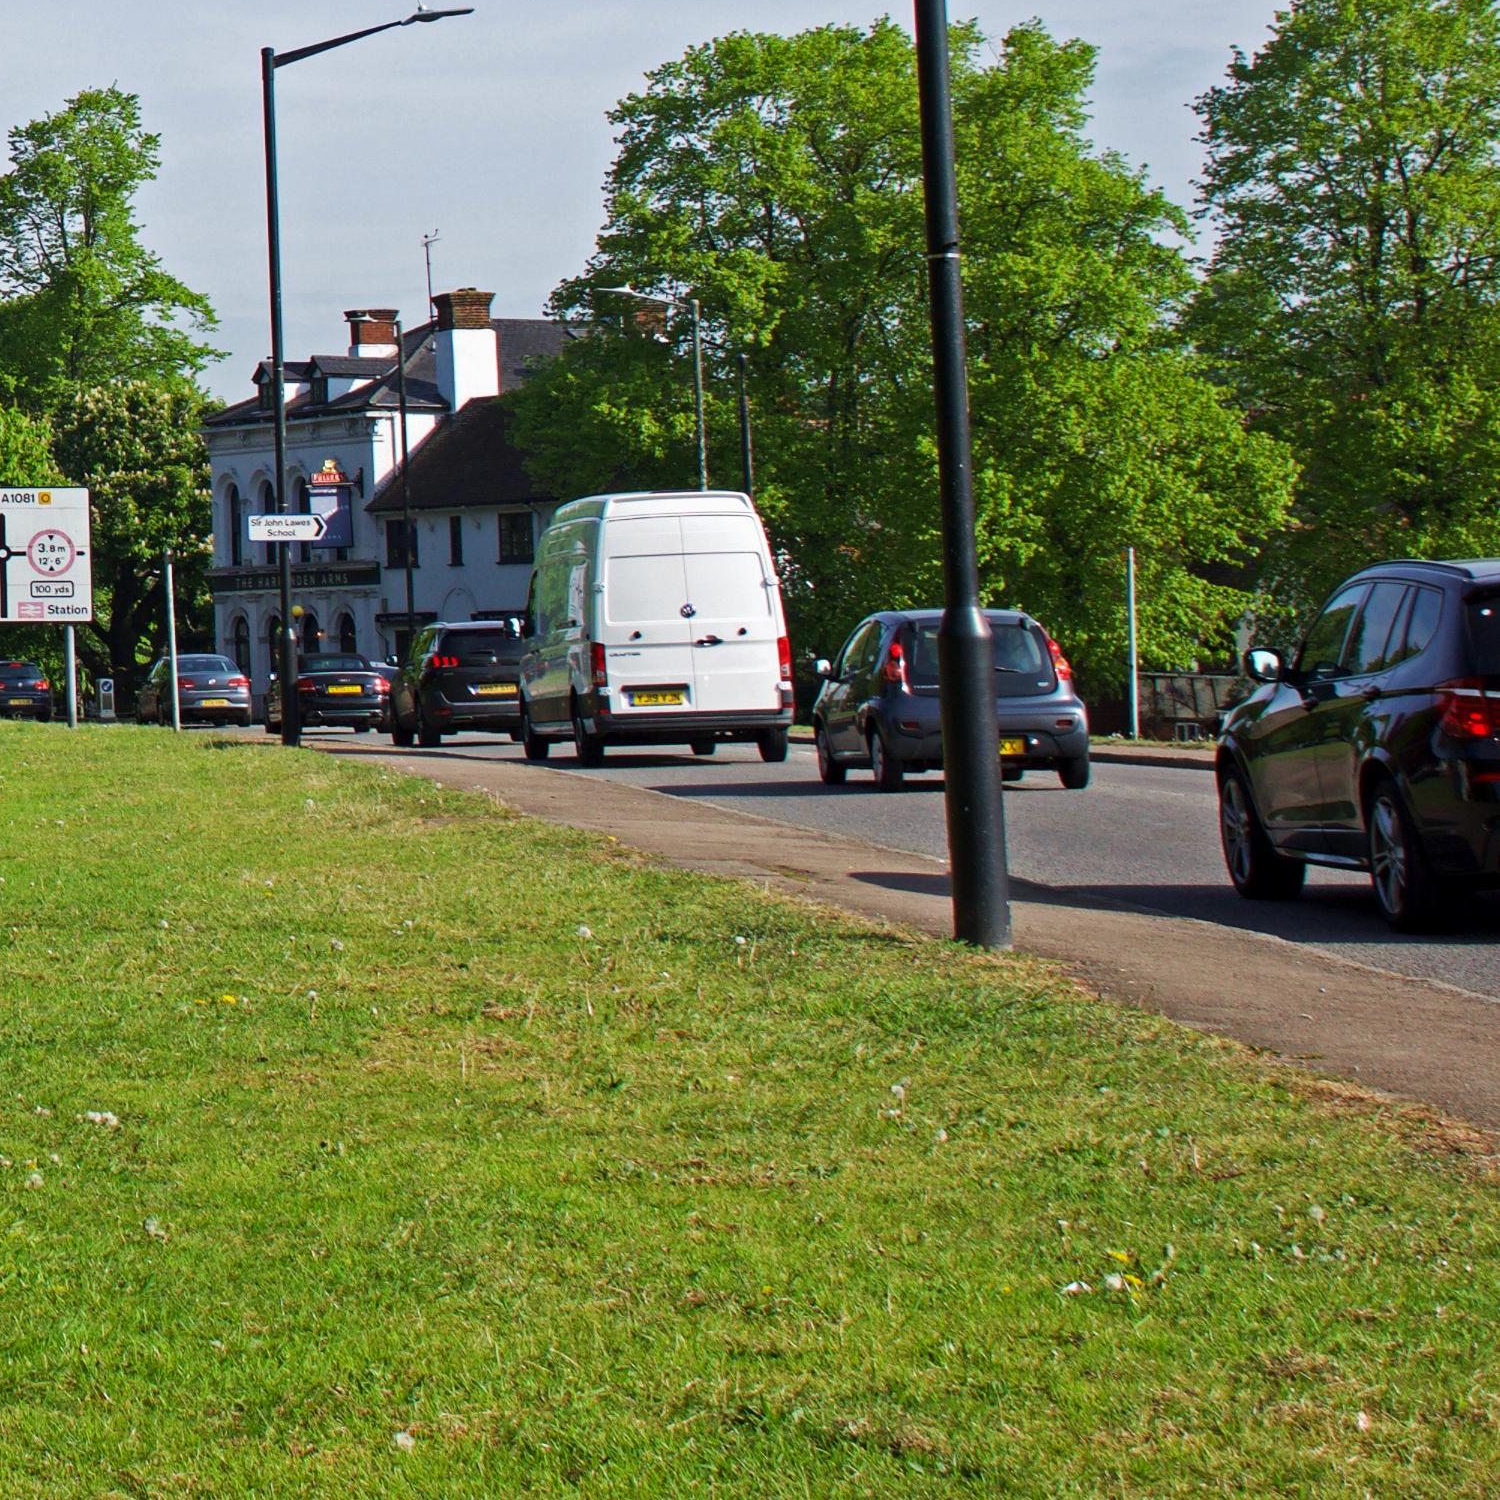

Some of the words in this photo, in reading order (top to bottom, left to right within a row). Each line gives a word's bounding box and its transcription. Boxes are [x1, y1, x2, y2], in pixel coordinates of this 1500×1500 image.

[1, 493, 35, 504] A1081
[251, 518, 261, 527] Sir
[264, 518, 283, 527] John
[285, 518, 311, 527] Lawes
[267, 528, 296, 537] School
[236, 577, 253, 589] THE
[257, 574, 319, 588] HARDEN
[321, 573, 349, 585] ARMS
[34, 585, 52, 594] 100
[54, 585, 70, 596] yds
[47, 604, 88, 615] Station
